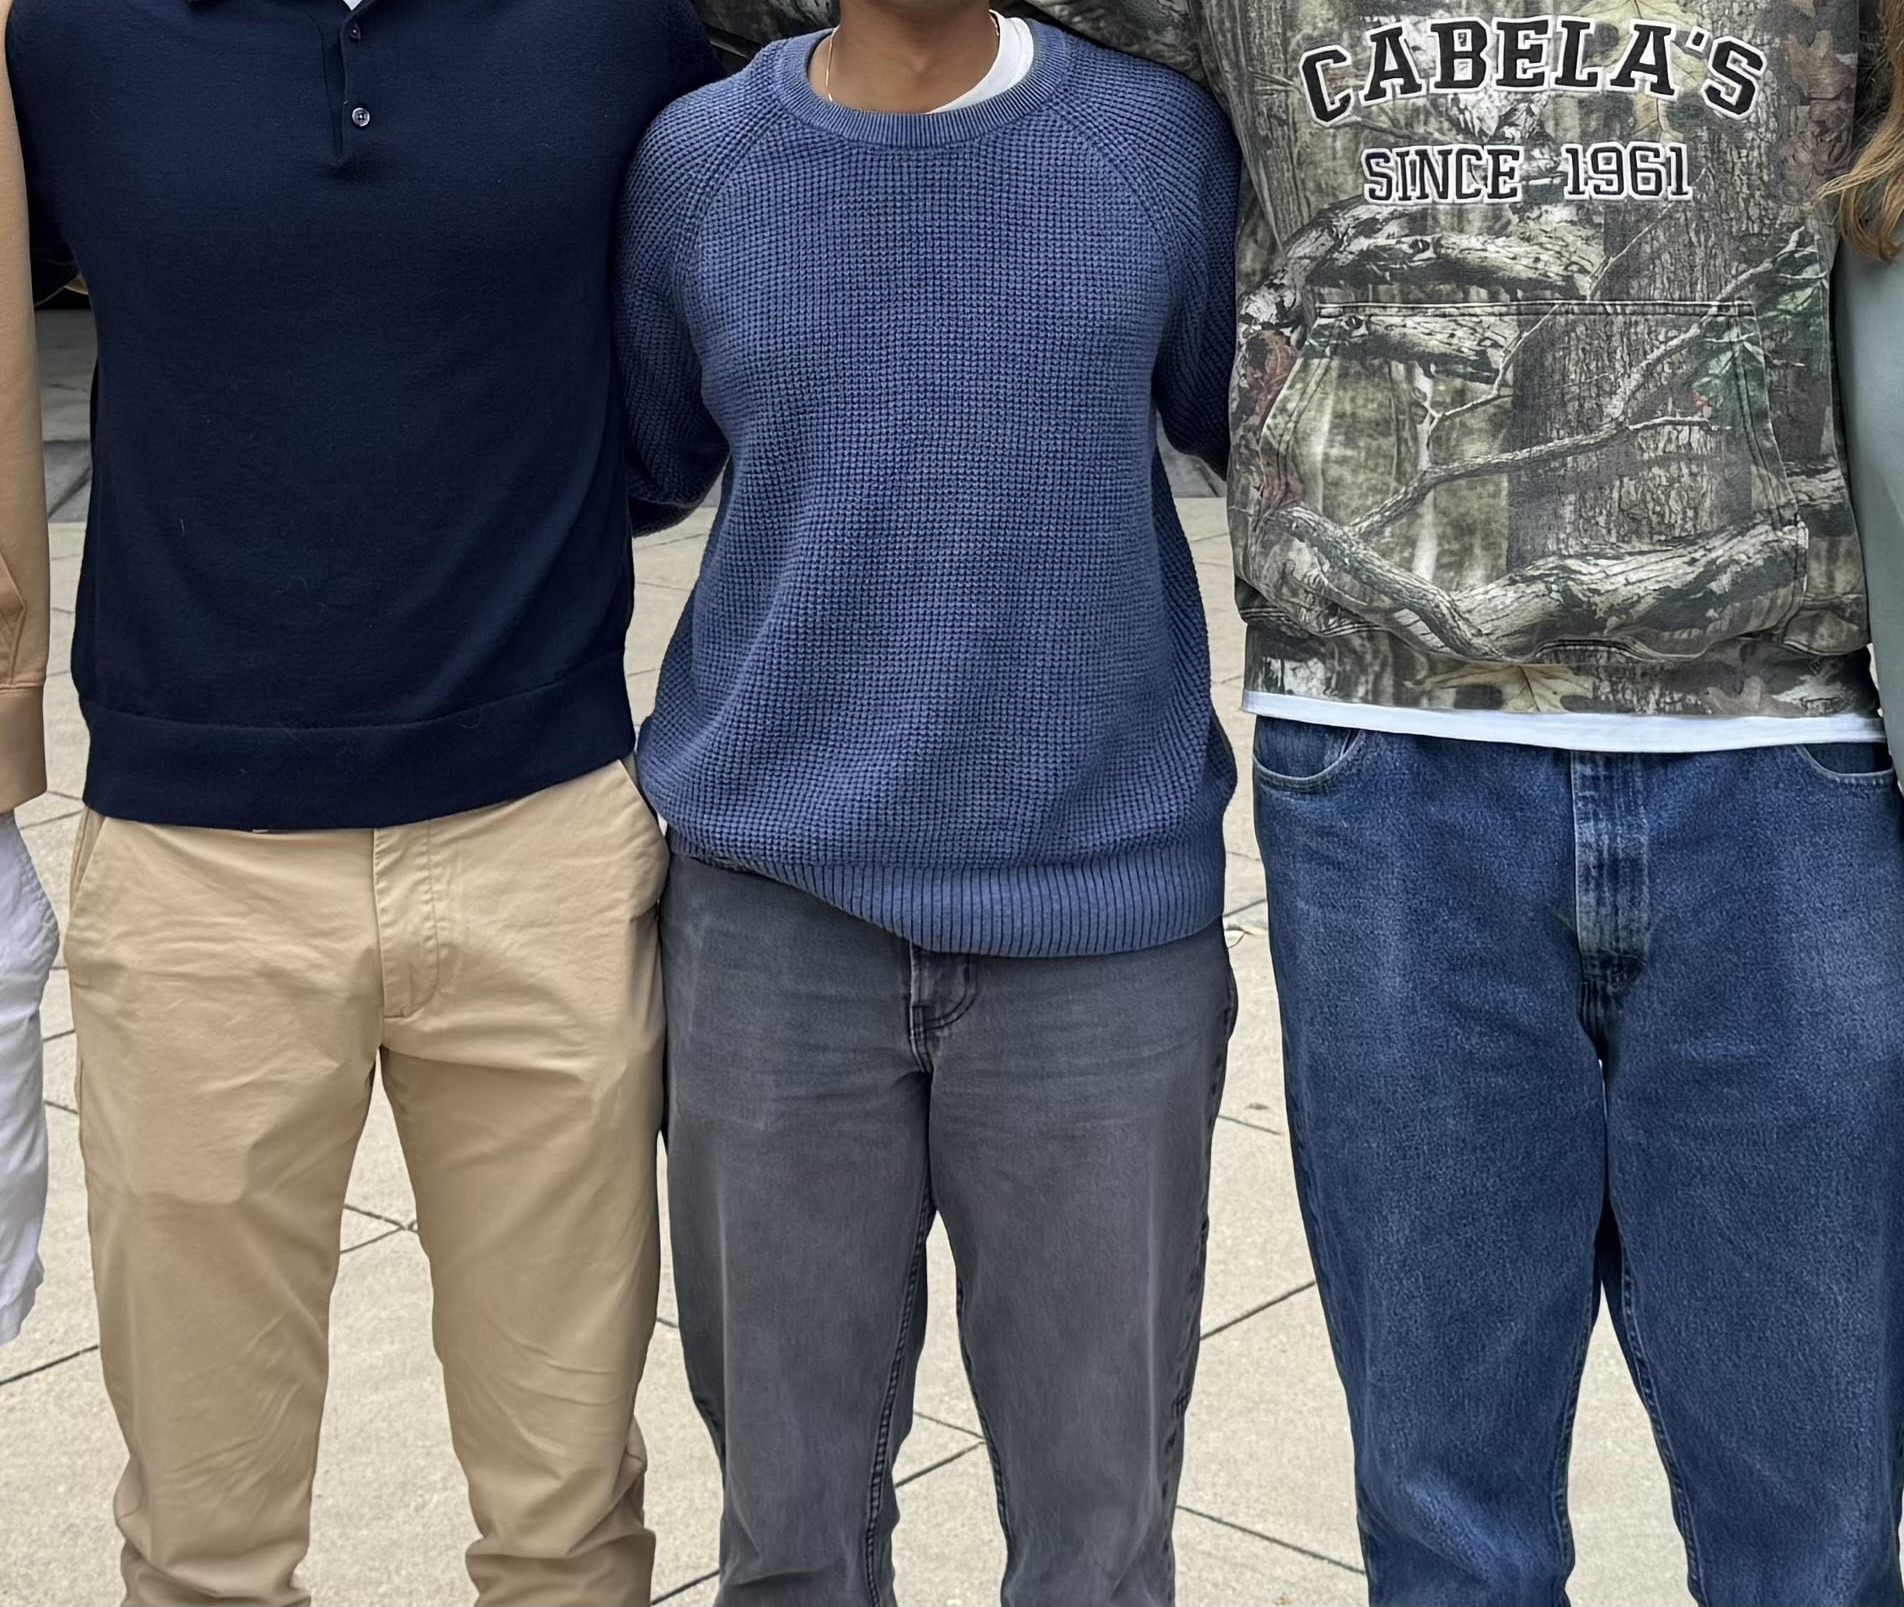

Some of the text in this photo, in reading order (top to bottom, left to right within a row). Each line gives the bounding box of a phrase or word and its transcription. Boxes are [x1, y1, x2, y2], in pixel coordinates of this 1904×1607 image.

[1299, 15, 1768, 130] CABELA'S
[1361, 141, 1693, 205] SINCE 1961
